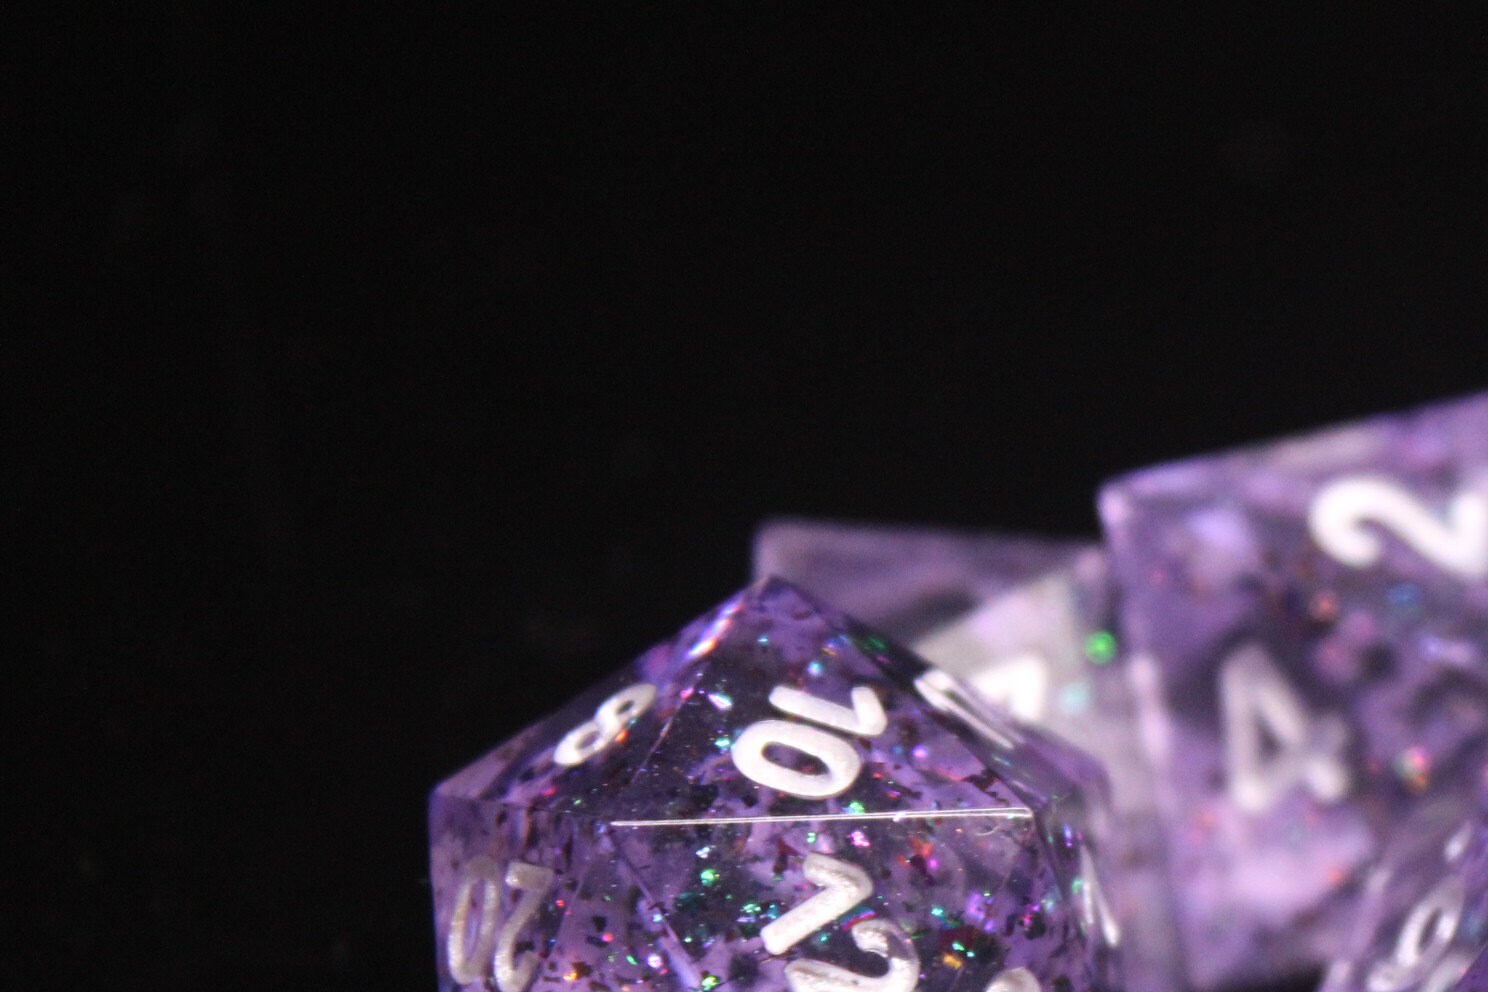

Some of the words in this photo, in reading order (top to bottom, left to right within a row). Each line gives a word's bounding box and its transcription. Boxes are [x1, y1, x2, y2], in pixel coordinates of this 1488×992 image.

[554, 683, 657, 767] 8
[732, 684, 888, 800] 10
[1220, 645, 1350, 814] 4
